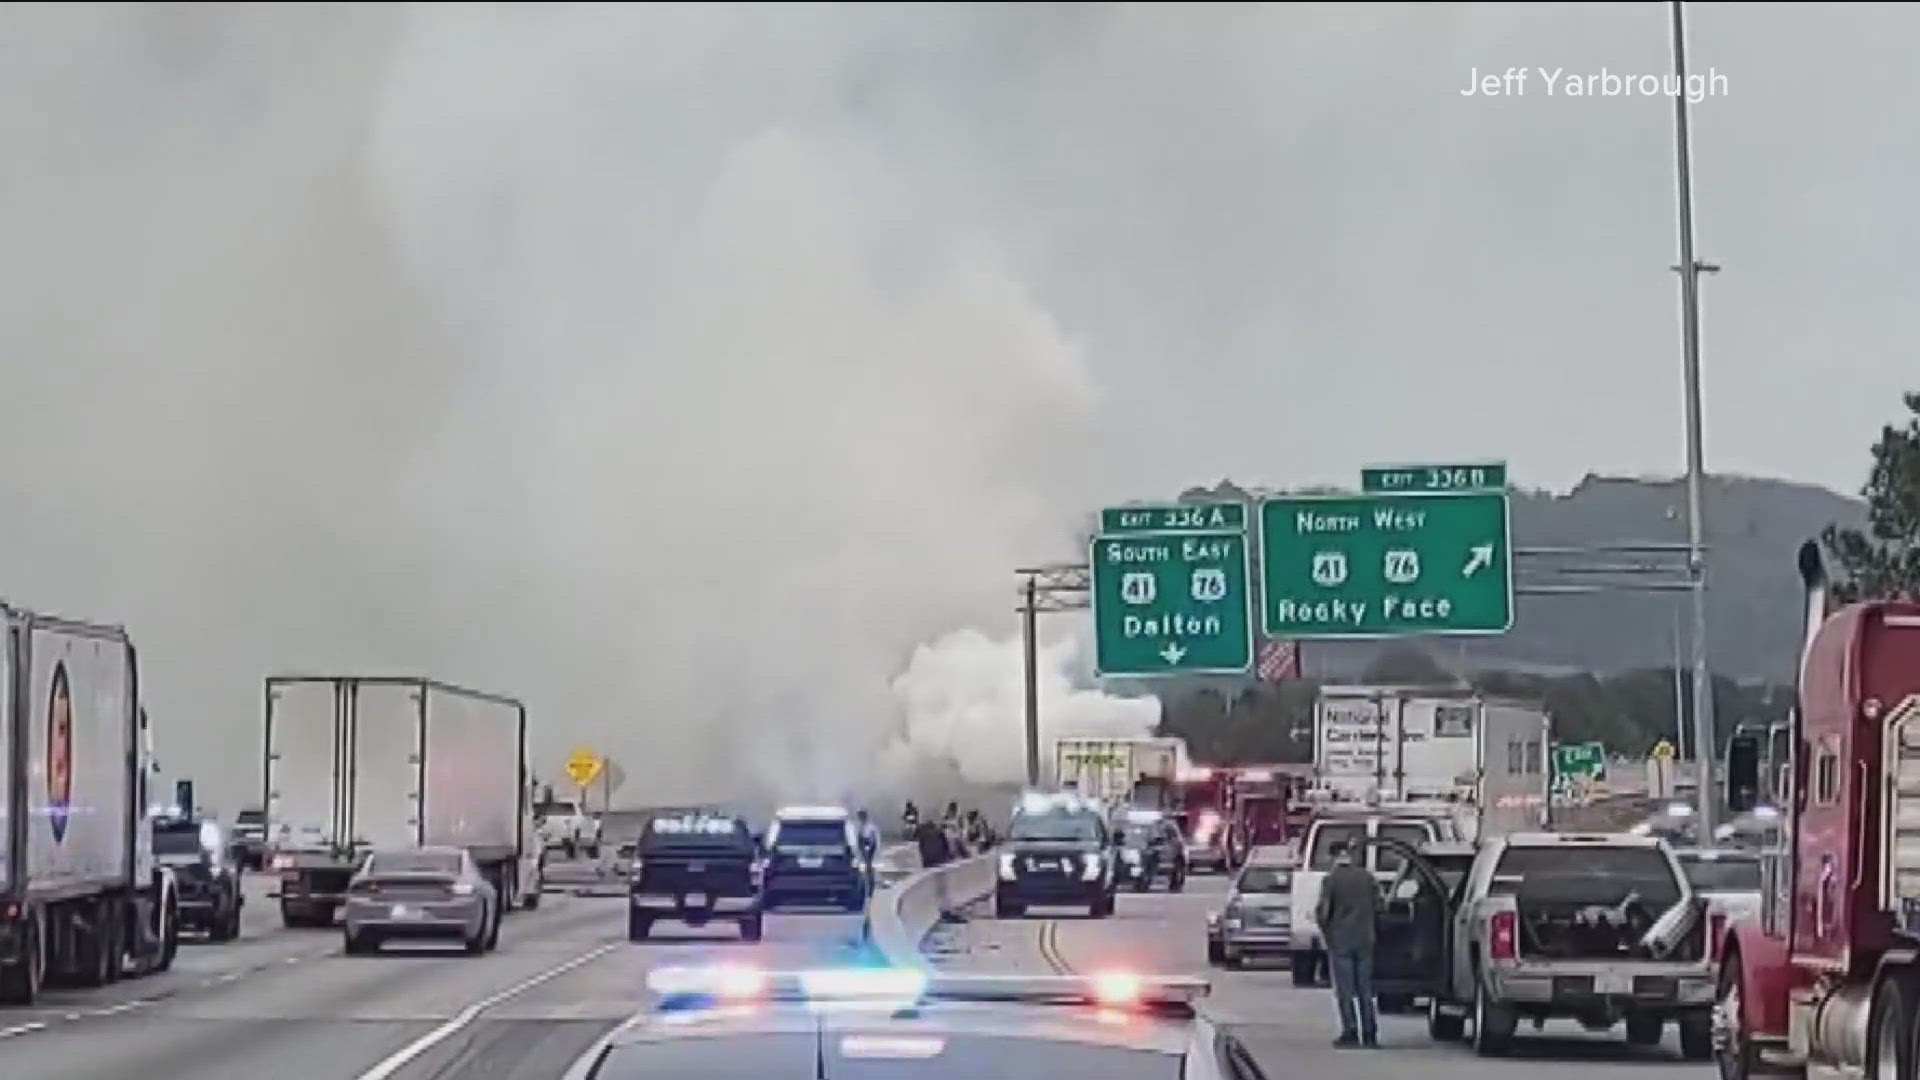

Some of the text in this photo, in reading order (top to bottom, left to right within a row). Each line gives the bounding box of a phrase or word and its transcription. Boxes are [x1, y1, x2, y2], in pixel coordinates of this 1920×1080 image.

[1381, 472, 1413, 488] EXIT
[1120, 512, 1152, 527] EXIT
[1296, 508, 1427, 533] NORTH WEST
[1106, 538, 1231, 564] SOUTH EAST
[1316, 556, 1416, 579] 41 76
[1126, 575, 1222, 598] 41 76
[1278, 595, 1452, 627] Rocky Face
[1123, 613, 1221, 638] Dalton
